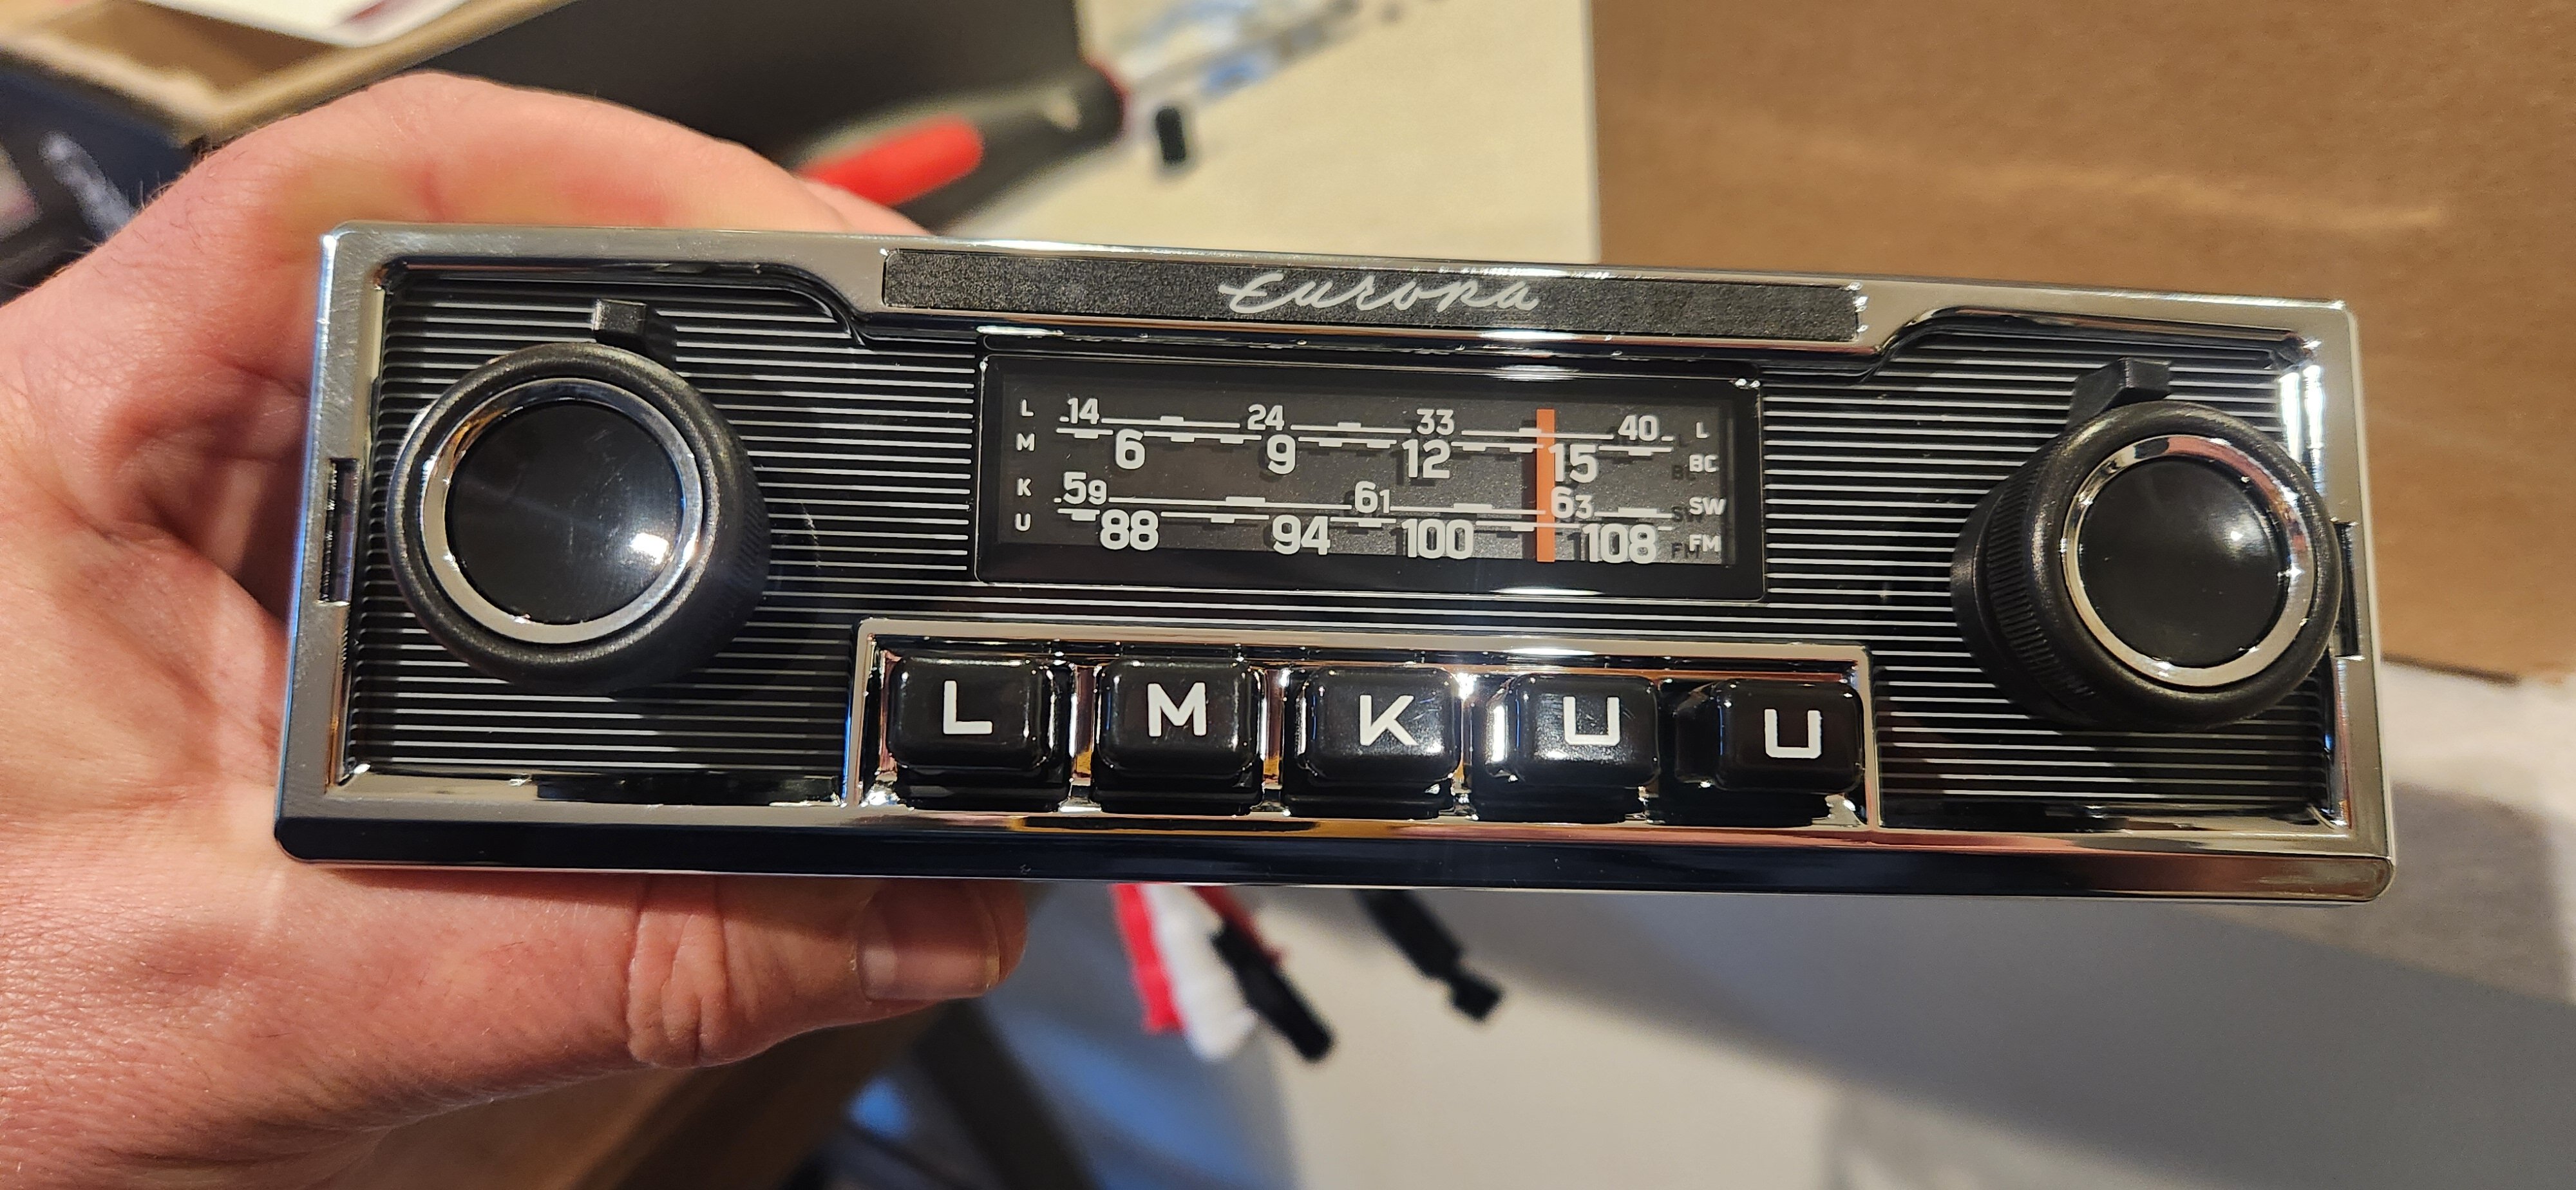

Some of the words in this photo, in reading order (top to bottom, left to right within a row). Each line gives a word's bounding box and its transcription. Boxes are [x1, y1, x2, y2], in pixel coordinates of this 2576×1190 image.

[1218, 272, 1539, 314] Europa
[1021, 399, 1034, 417] L
[1068, 398, 1100, 424] 14
[1247, 404, 1285, 431] 24
[1417, 409, 1455, 435] 33
[1618, 415, 1661, 442] 40
[1695, 421, 1709, 439] L
[1016, 433, 1035, 451] M
[1115, 429, 1146, 470] 6
[1267, 435, 1296, 475] 9
[1401, 439, 1450, 478] 12
[1548, 444, 1598, 483] 15
[1689, 454, 1718, 473] BC
[1018, 478, 1032, 496] K
[1063, 472, 1107, 505] 59
[1354, 481, 1390, 514] 61
[1551, 487, 1593, 519] 63
[1689, 497, 1726, 515] SW
[1015, 514, 1030, 531] U
[1100, 509, 1159, 551] 88
[1272, 515, 1331, 555] 94
[1401, 518, 1474, 560] 100
[1583, 523, 1657, 565] 108
[1689, 534, 1721, 552] FM
[943, 681, 992, 735] L
[1147, 682, 1206, 737] M
[1358, 694, 1418, 747] K
[1562, 696, 1620, 746] U
[1765, 709, 1822, 759] U
